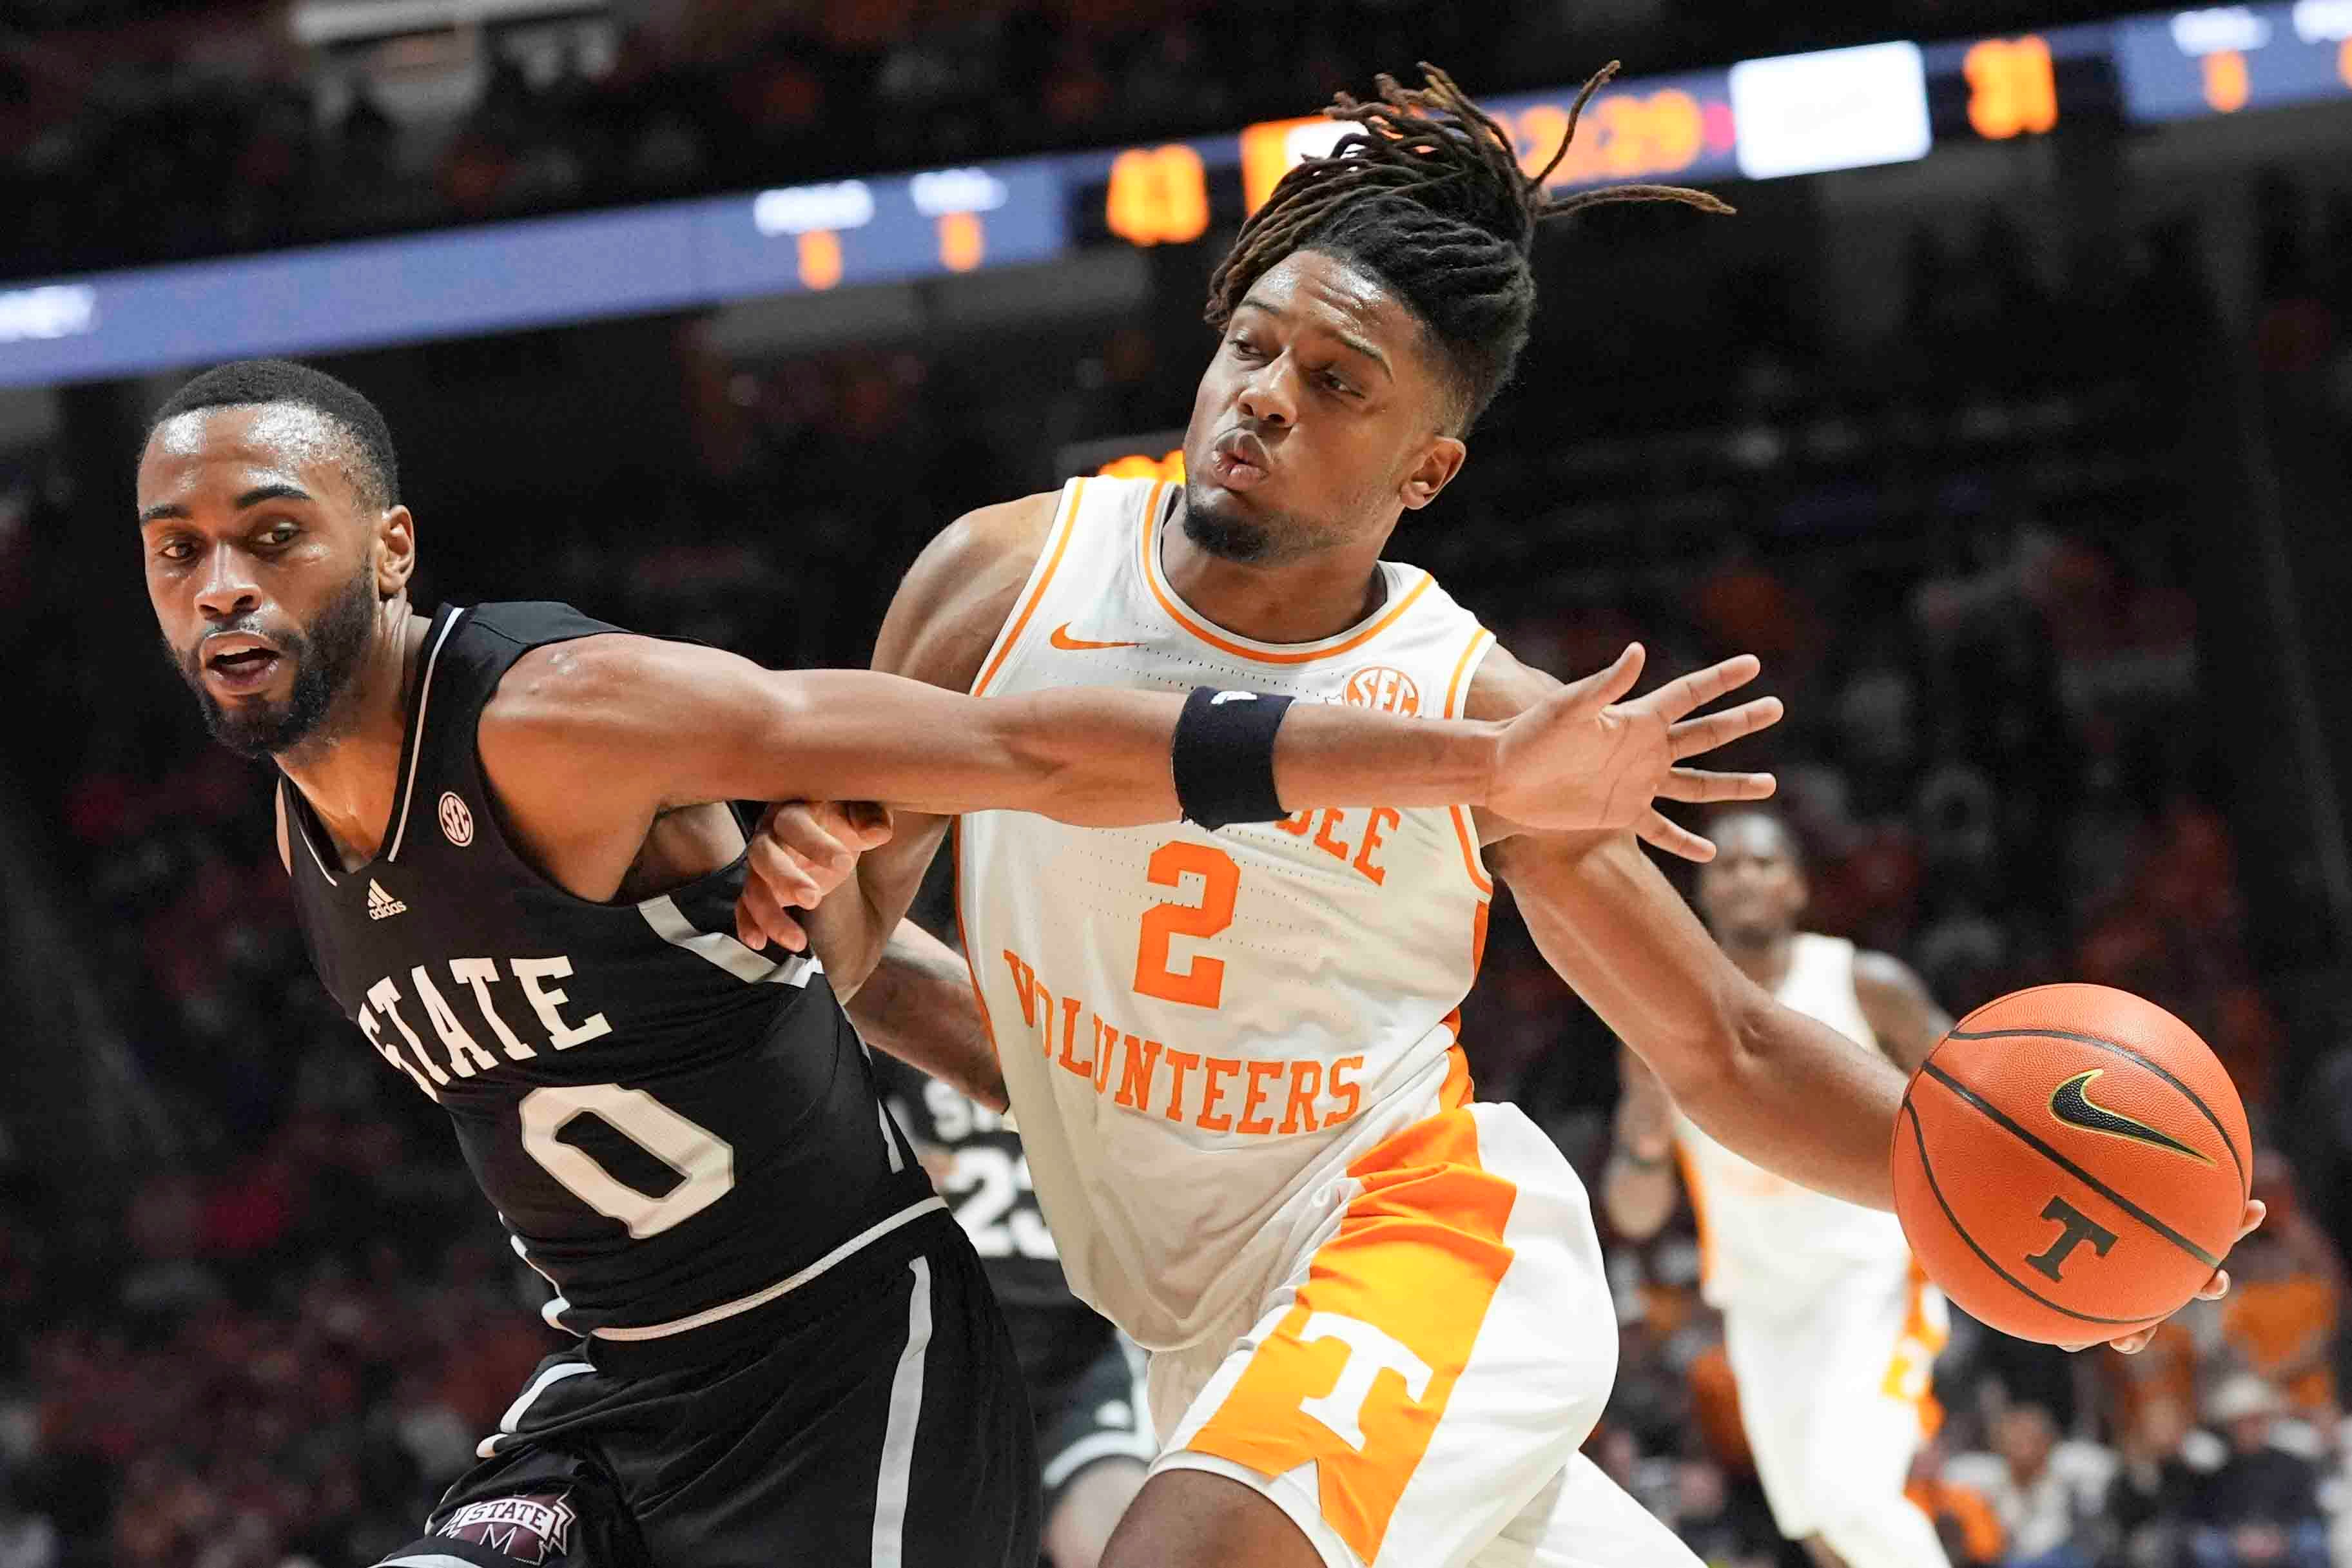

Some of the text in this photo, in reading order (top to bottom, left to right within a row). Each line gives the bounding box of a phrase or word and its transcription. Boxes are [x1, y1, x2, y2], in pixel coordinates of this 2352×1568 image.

[1351, 669, 1416, 717] SEC
[442, 796, 469, 841] SEC
[368, 901, 407, 920] adidas
[1133, 840, 1241, 1010] 2
[357, 955, 613, 1103] STATE
[1003, 949, 1365, 1136] VOLUNTEERS
[519, 1083, 735, 1240] 0
[2024, 1195, 2119, 1282] T
[1299, 1310, 1434, 1453] T
[468, 1501, 547, 1531] STATE
